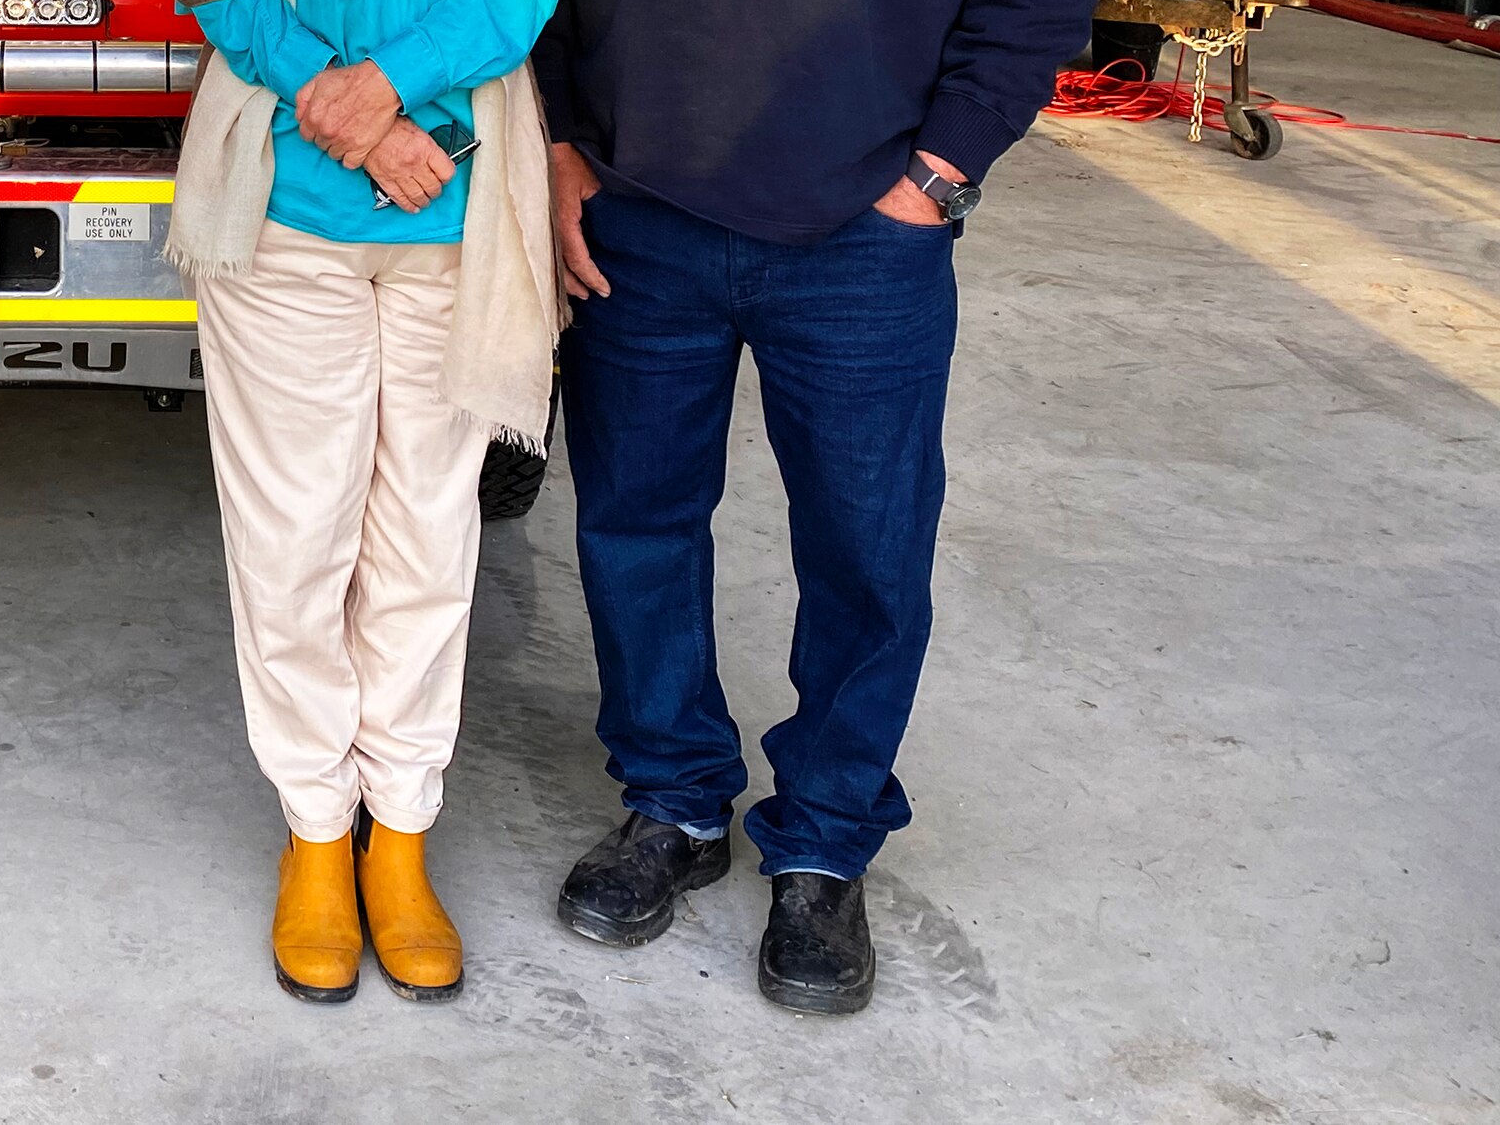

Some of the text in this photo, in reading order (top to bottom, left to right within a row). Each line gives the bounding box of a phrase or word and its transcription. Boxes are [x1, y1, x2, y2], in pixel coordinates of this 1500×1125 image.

[101, 207, 117, 216] PIN
[85, 218, 133, 227] RECOVERY
[85, 229, 133, 238] USE ONLY
